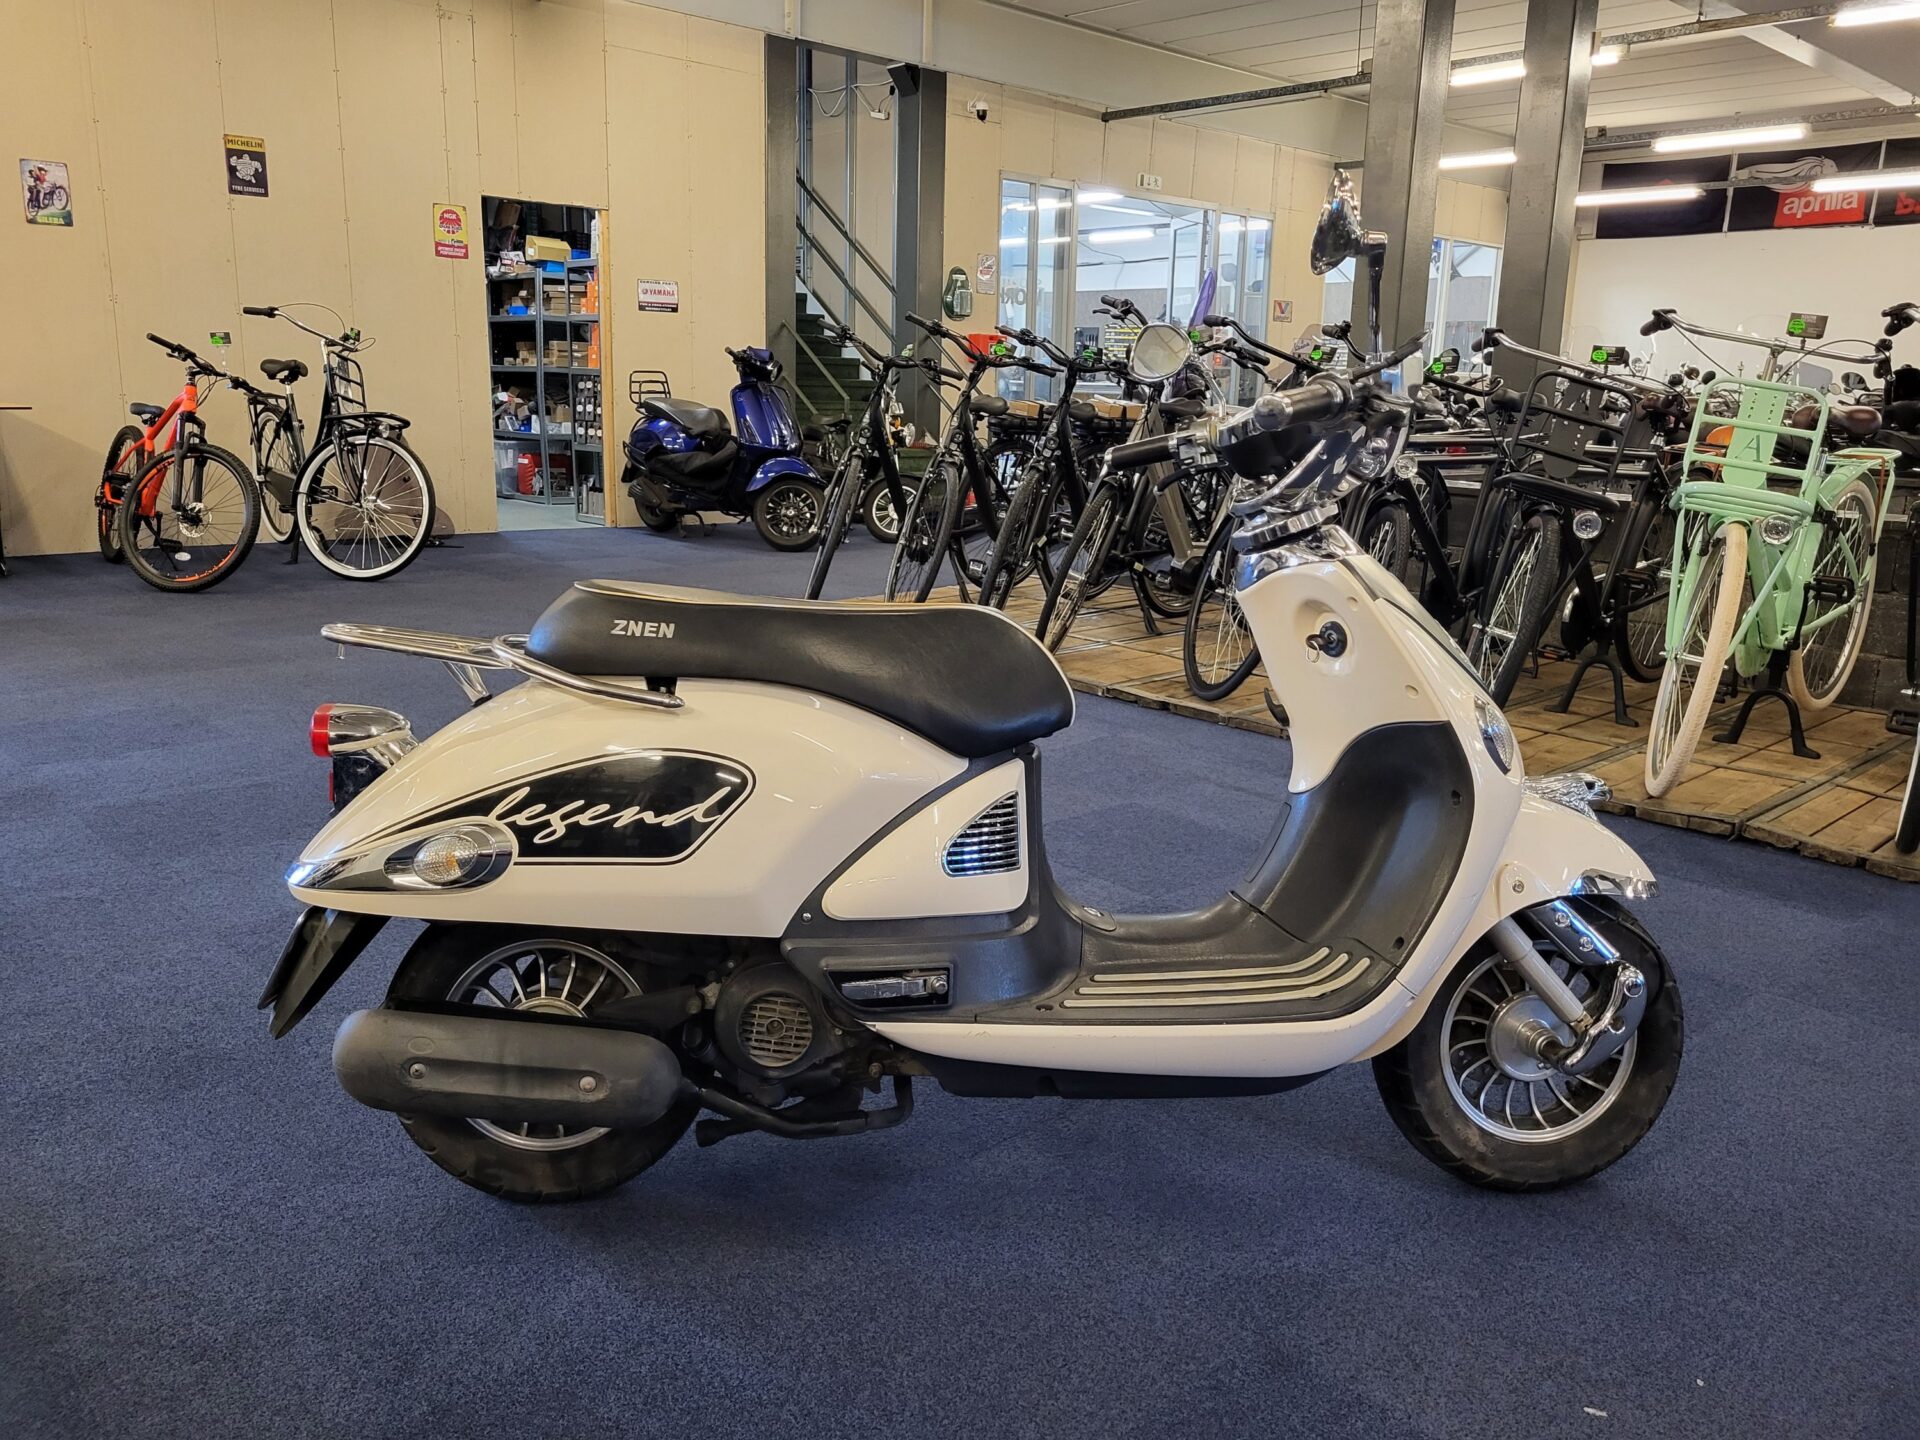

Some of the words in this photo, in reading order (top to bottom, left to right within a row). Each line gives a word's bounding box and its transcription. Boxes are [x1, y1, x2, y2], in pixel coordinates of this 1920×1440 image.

[227, 138, 263, 149] MICHELIN
[1782, 190, 1858, 219] aprilia
[649, 288, 675, 297] YAMAHA
[610, 619, 675, 639] ZNEN
